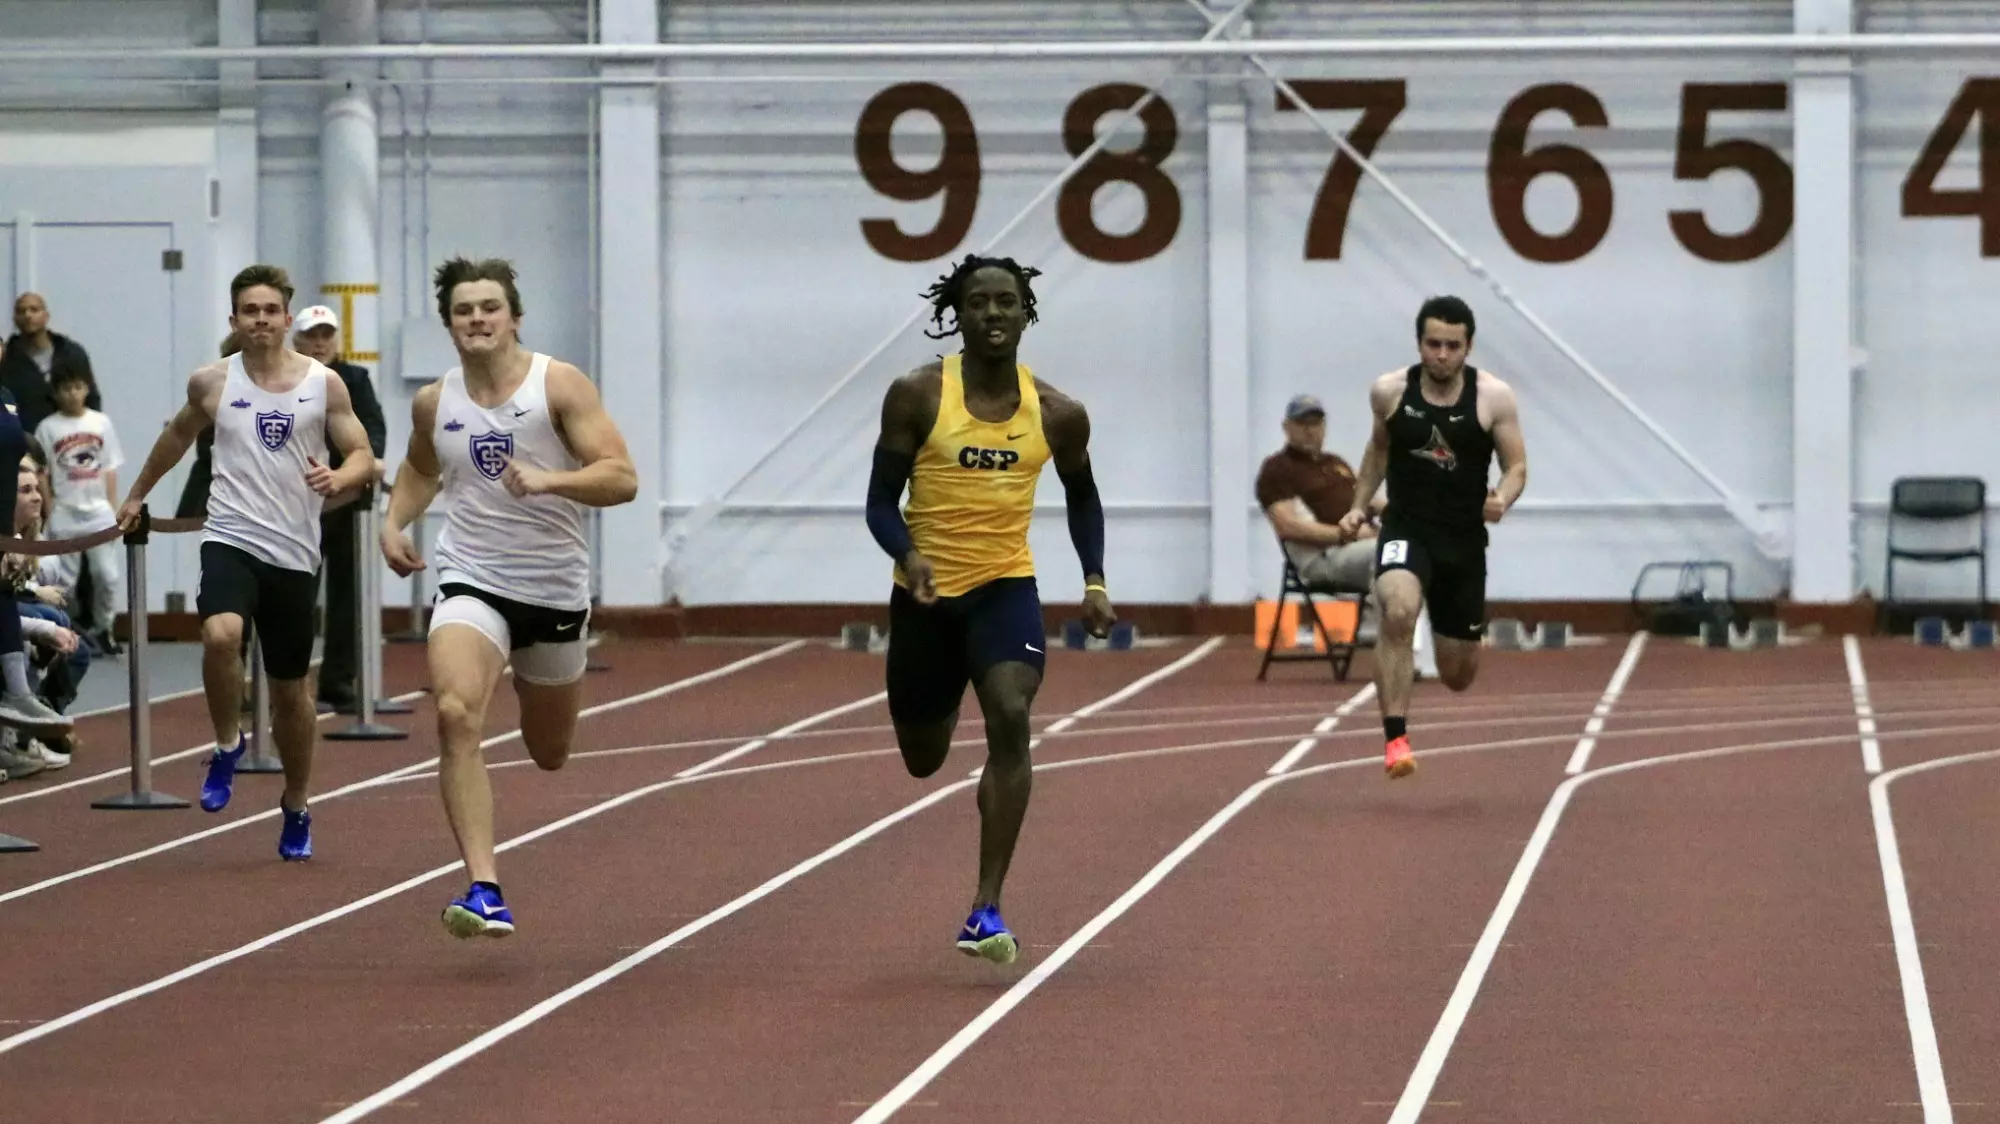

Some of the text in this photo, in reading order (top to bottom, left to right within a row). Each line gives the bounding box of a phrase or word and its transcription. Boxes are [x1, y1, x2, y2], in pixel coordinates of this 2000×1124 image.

[856, 78, 2000, 263] 9 8 7 6 5 4
[958, 446, 1019, 471] CSP
[1387, 541, 1401, 562] 3
